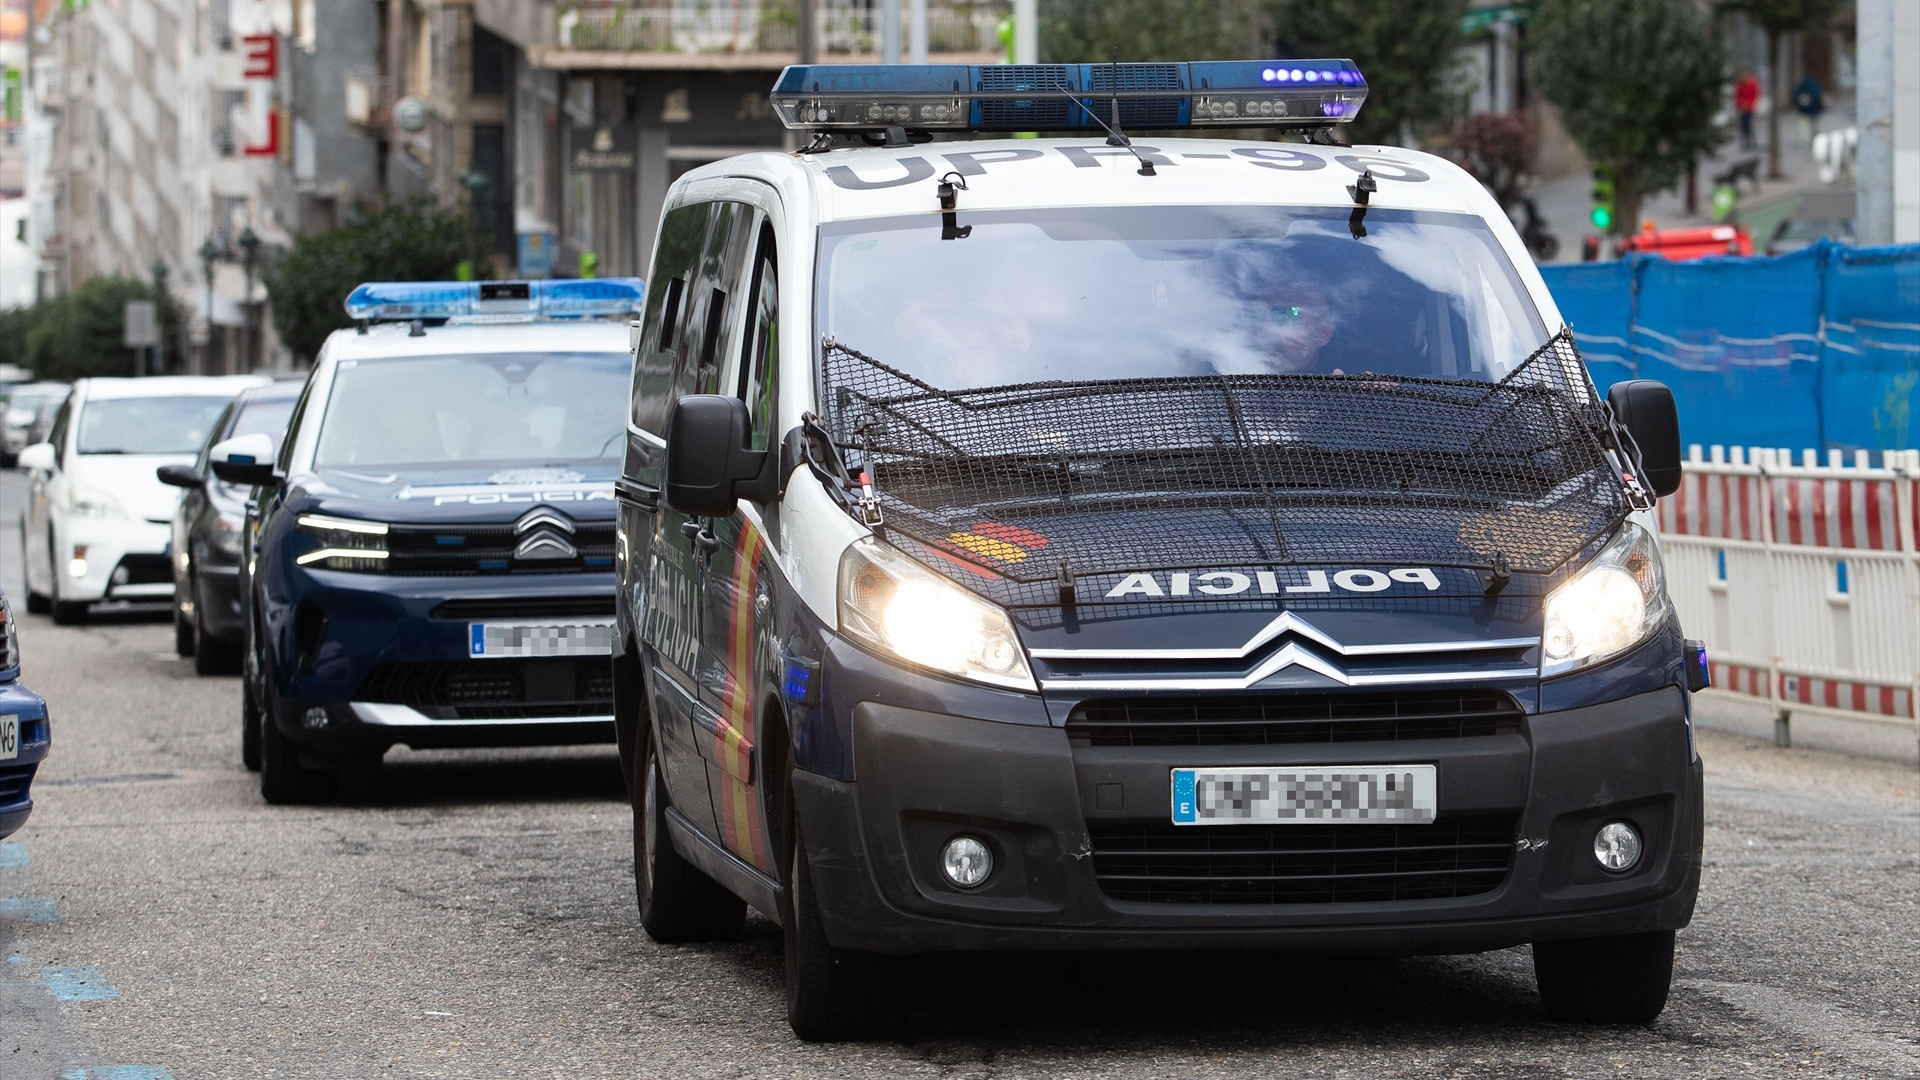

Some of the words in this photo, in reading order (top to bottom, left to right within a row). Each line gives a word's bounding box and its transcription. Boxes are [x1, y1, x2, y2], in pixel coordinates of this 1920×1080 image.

[826, 144, 1431, 190] UPR-96
[434, 491, 616, 506] POLICIA
[644, 554, 701, 677] POLICIA
[1180, 803, 1190, 814] E
